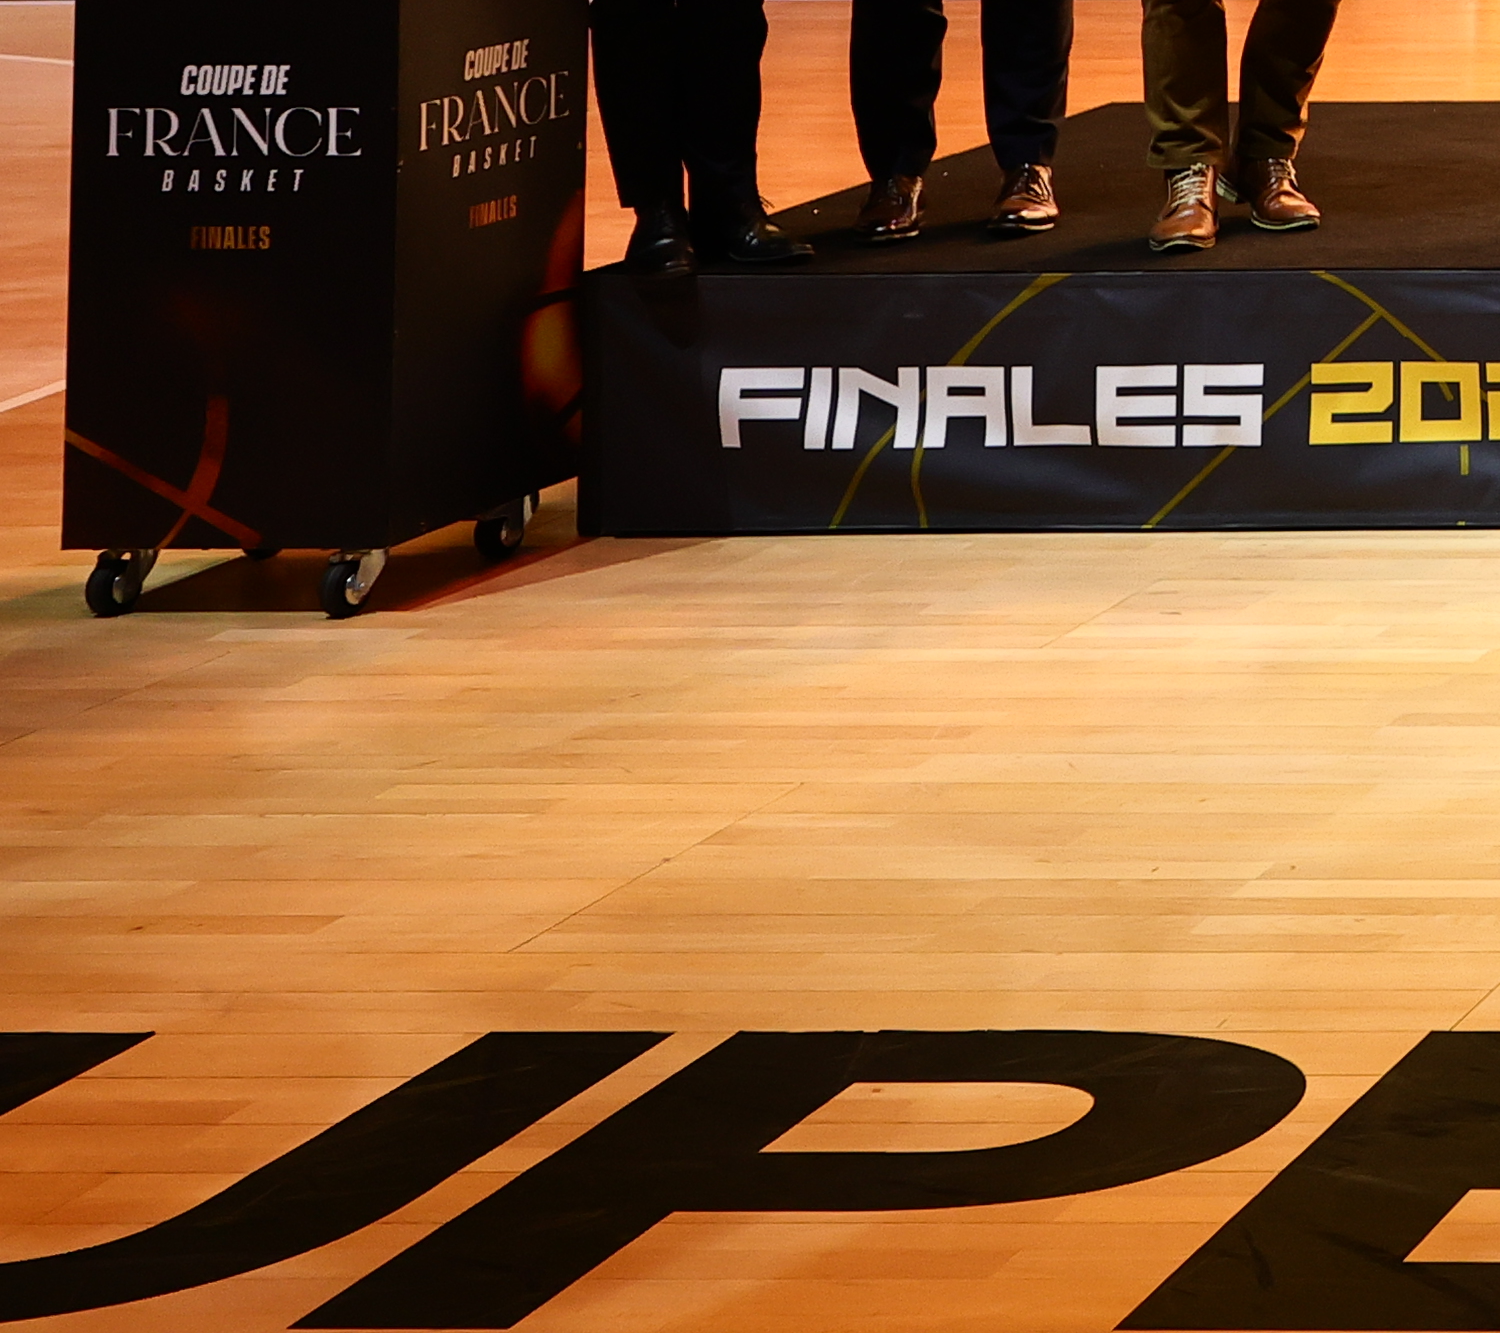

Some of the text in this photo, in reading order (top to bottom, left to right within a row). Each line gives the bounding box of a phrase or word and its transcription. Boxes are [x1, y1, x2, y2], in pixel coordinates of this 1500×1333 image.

[180, 64, 291, 96] COUPE DE
[463, 38, 530, 81] COUPE DE
[106, 107, 362, 157] FRANCE
[419, 71, 570, 152] FRANCE
[452, 135, 537, 178] BASKET
[161, 169, 304, 192] BASKET
[190, 226, 271, 250] FINALES
[718, 365, 1264, 450] FINALES
